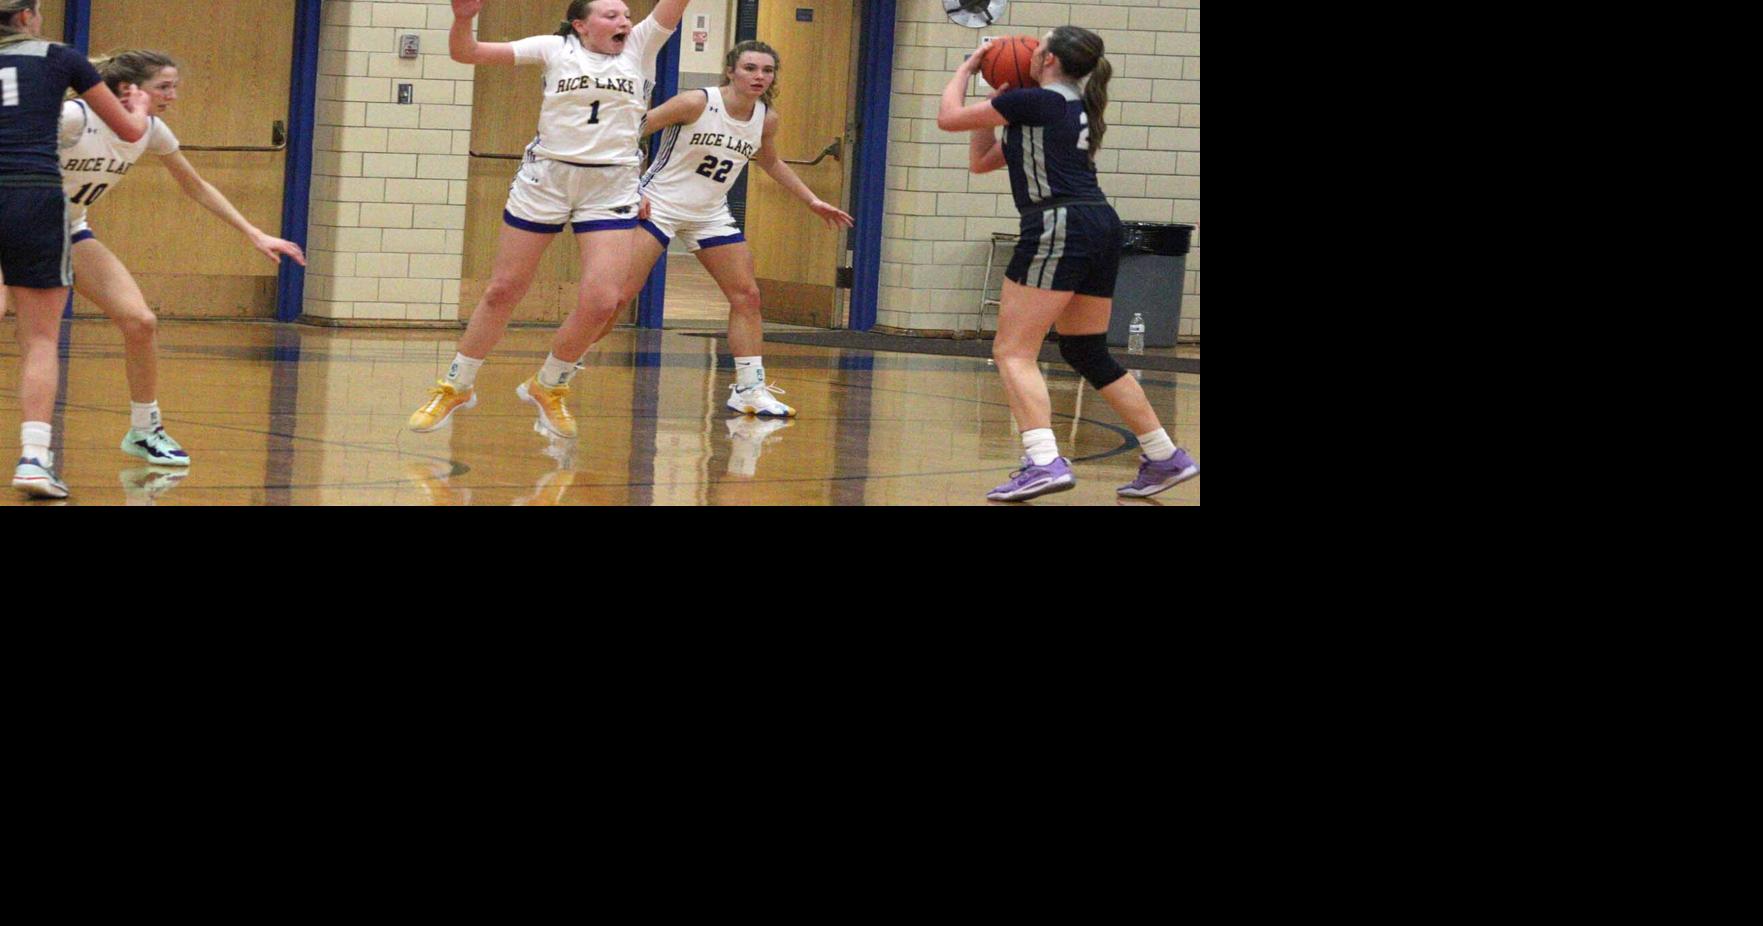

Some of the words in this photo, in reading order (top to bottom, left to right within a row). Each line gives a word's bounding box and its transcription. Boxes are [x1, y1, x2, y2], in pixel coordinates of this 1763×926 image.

[556, 75, 590, 93] RICE
[595, 78, 634, 94] LAKE
[587, 100, 600, 124] 1
[689, 133, 725, 146] RICE
[64, 158, 104, 172] RICE
[695, 155, 734, 183] 22
[70, 182, 108, 206] 10
